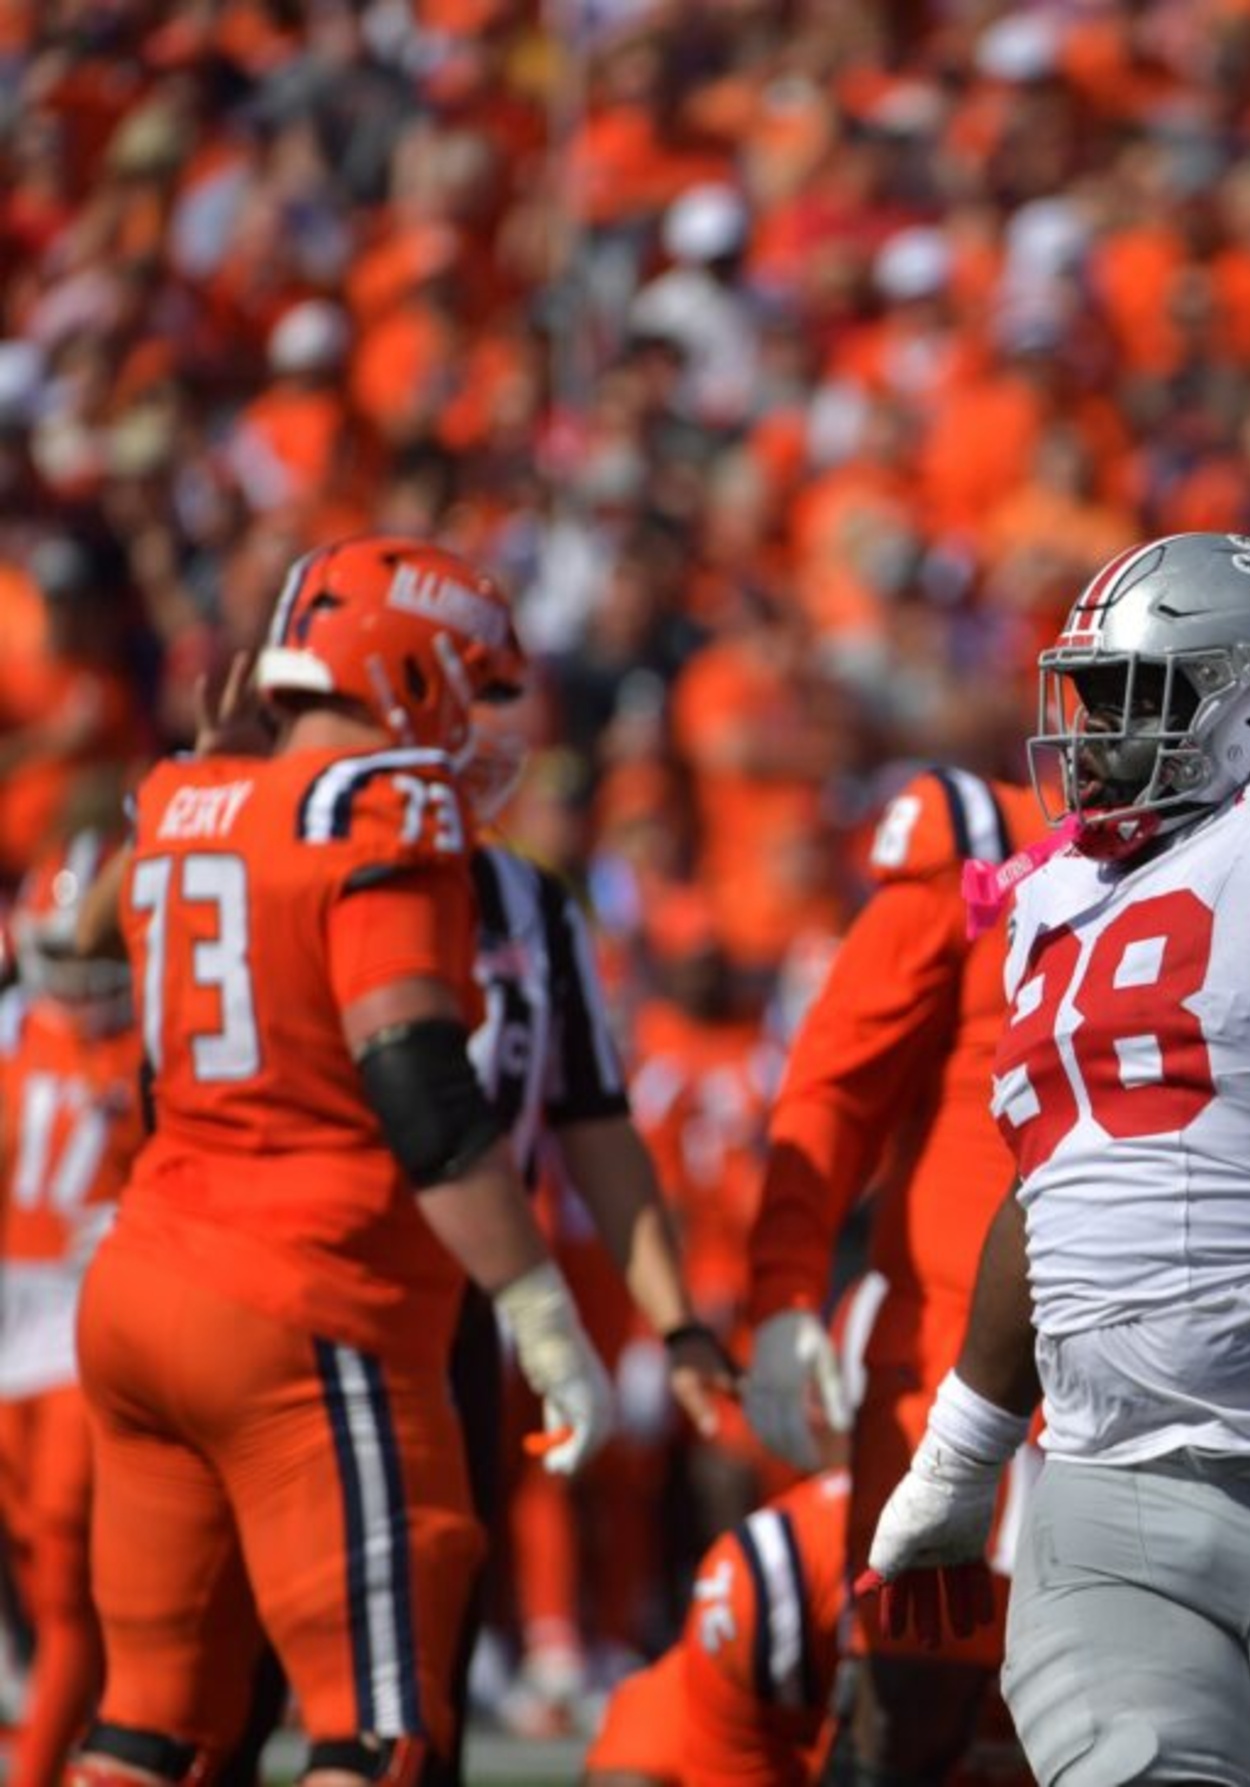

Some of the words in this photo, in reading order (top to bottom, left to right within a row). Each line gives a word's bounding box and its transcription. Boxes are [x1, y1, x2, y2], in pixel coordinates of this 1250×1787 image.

[393, 773, 463, 852] 73
[131, 853, 260, 1081] 73
[990, 888, 1217, 1182] 98
